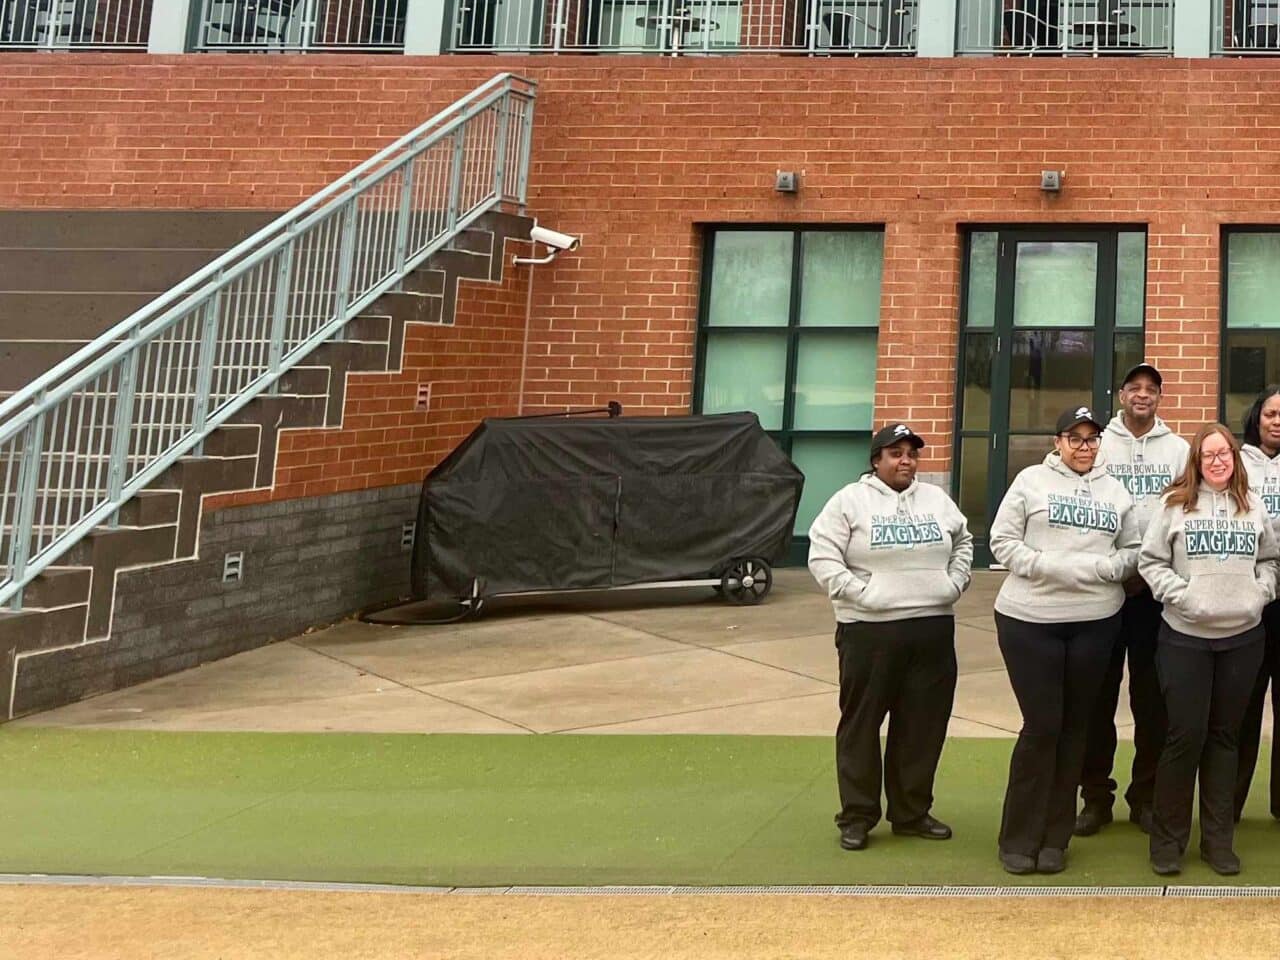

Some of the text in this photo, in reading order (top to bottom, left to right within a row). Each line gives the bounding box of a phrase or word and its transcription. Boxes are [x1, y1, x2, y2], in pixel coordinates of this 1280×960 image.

[1106, 464, 1132, 474] SUPER
[1049, 504, 1117, 531] EAGLES
[1185, 520, 1214, 530] SUPER
[1242, 520, 1255, 531] LIX
[872, 523, 942, 544] EAGLES
[1186, 531, 1255, 554] EAGLES
